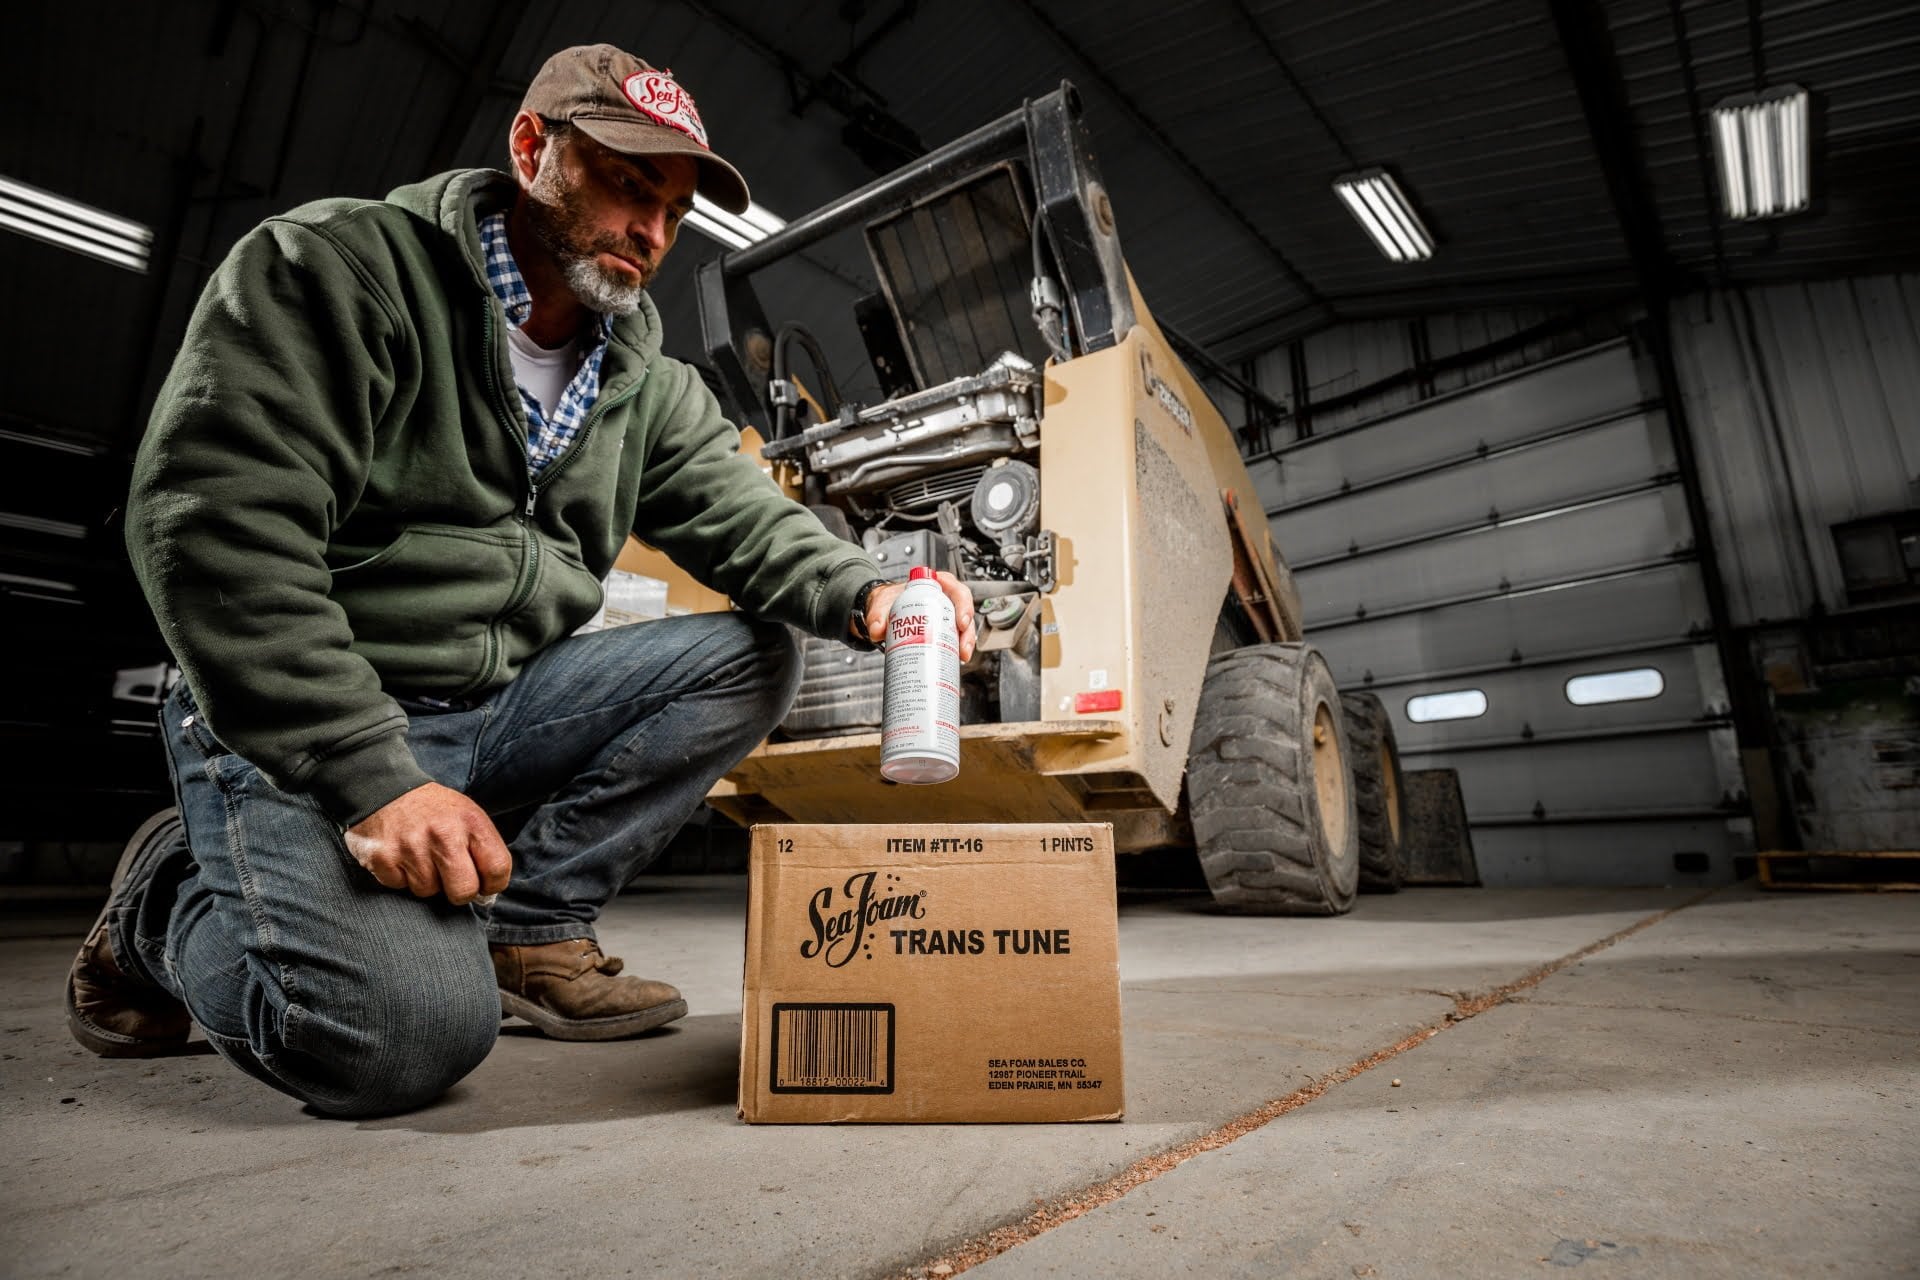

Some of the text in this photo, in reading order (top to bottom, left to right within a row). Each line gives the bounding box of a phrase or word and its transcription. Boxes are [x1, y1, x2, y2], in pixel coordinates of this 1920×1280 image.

[891, 615, 929, 630] TRANS
[893, 626, 925, 640] TUNE
[778, 837, 1094, 853] 12 ITEM #TT-16 1 PINTS
[890, 929, 1071, 955] TRANS TUNE
[988, 1058, 1087, 1068] SEA FOAM SALES CO.
[988, 1070, 1086, 1079] 12987 PIONEER TRAIL
[780, 1077, 885, 1087] 0 18812 00022 4
[988, 1081, 1103, 1091] EDEN PRAIRIE, MN 55347
